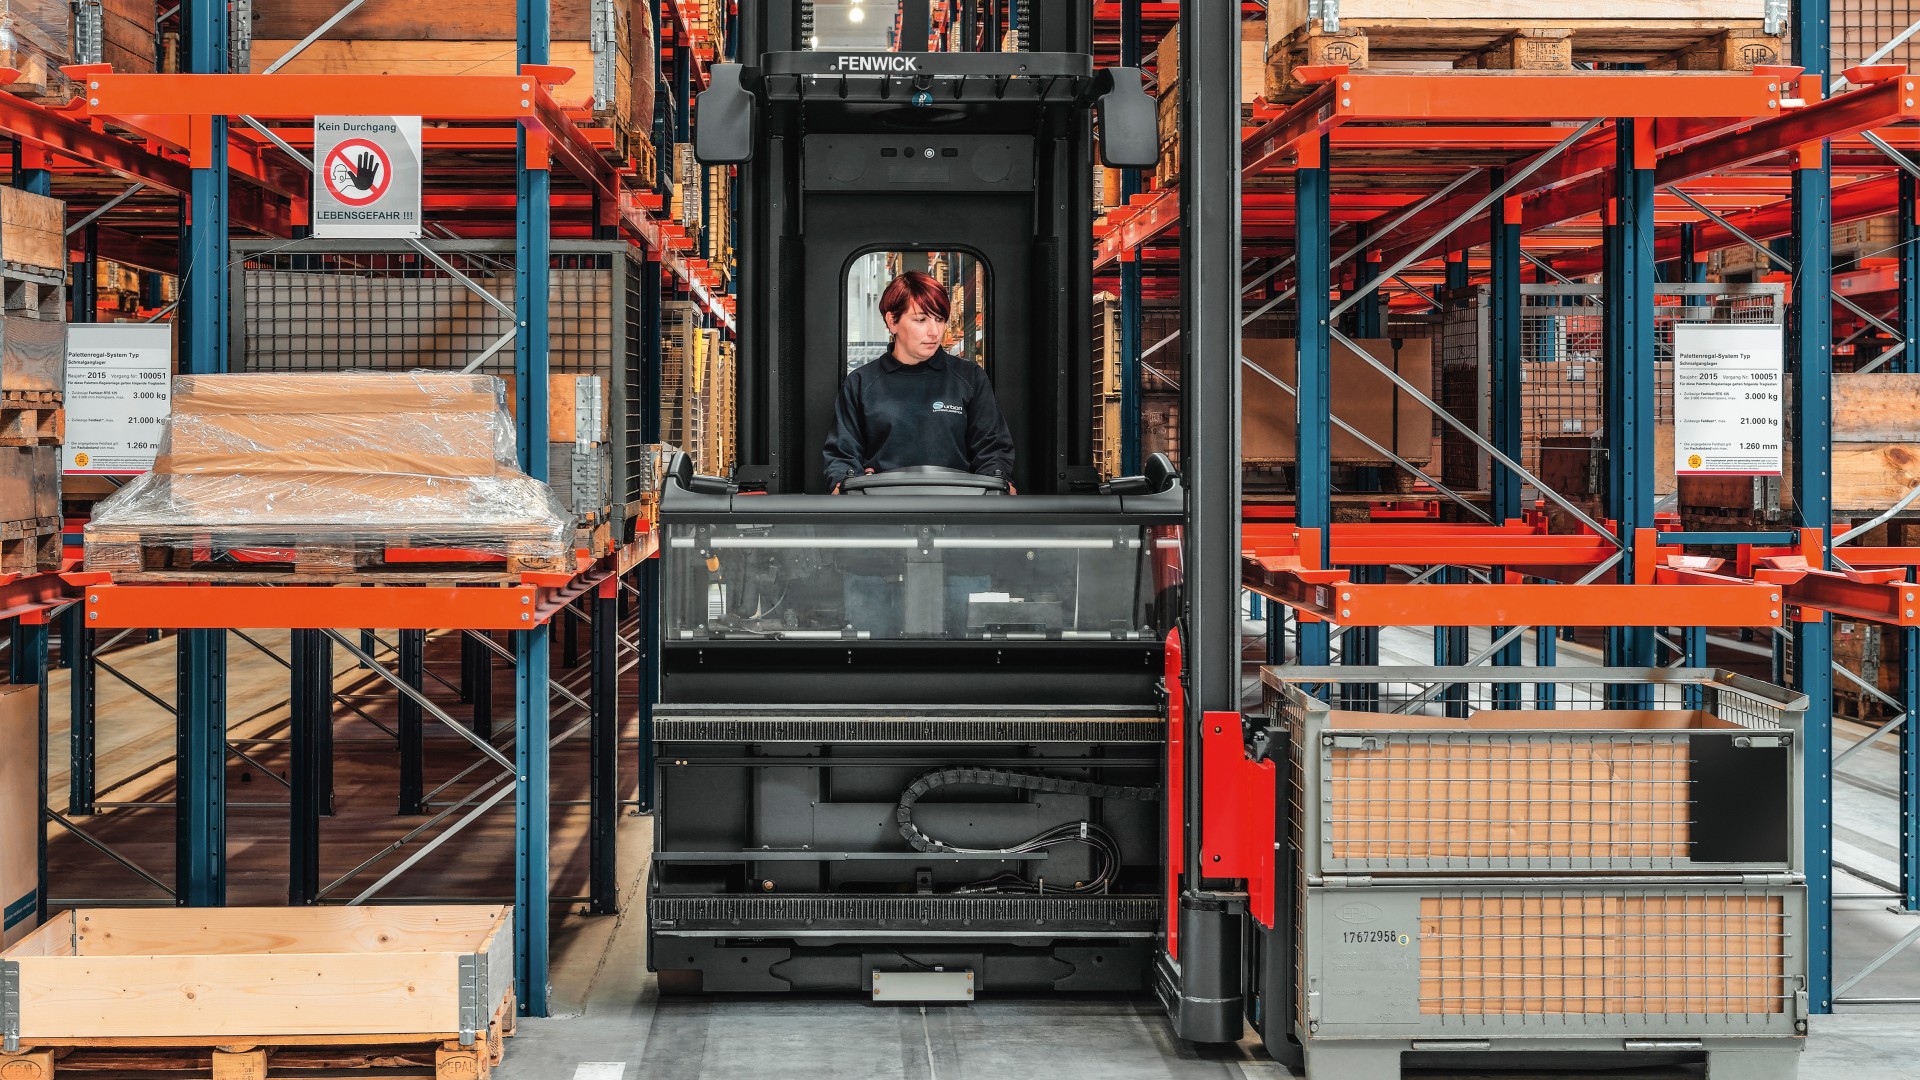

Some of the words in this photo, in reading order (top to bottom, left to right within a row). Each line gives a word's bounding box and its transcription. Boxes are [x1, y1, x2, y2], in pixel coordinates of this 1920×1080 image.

[1328, 46, 1355, 60] EPAL
[1744, 49, 1766, 64] EUR
[838, 56, 917, 71] FENWICK
[318, 123, 340, 131] Kein
[343, 123, 397, 133] Durchgang
[318, 212, 400, 220] LEBENSGEFAHR
[403, 212, 413, 220] !!!
[140, 372, 166, 380] 100051
[157, 392, 166, 400] kg
[1768, 393, 1778, 401] kg
[157, 417, 165, 425] kg
[1768, 418, 1778, 426] kg
[1344, 930, 1397, 943] 17672958
